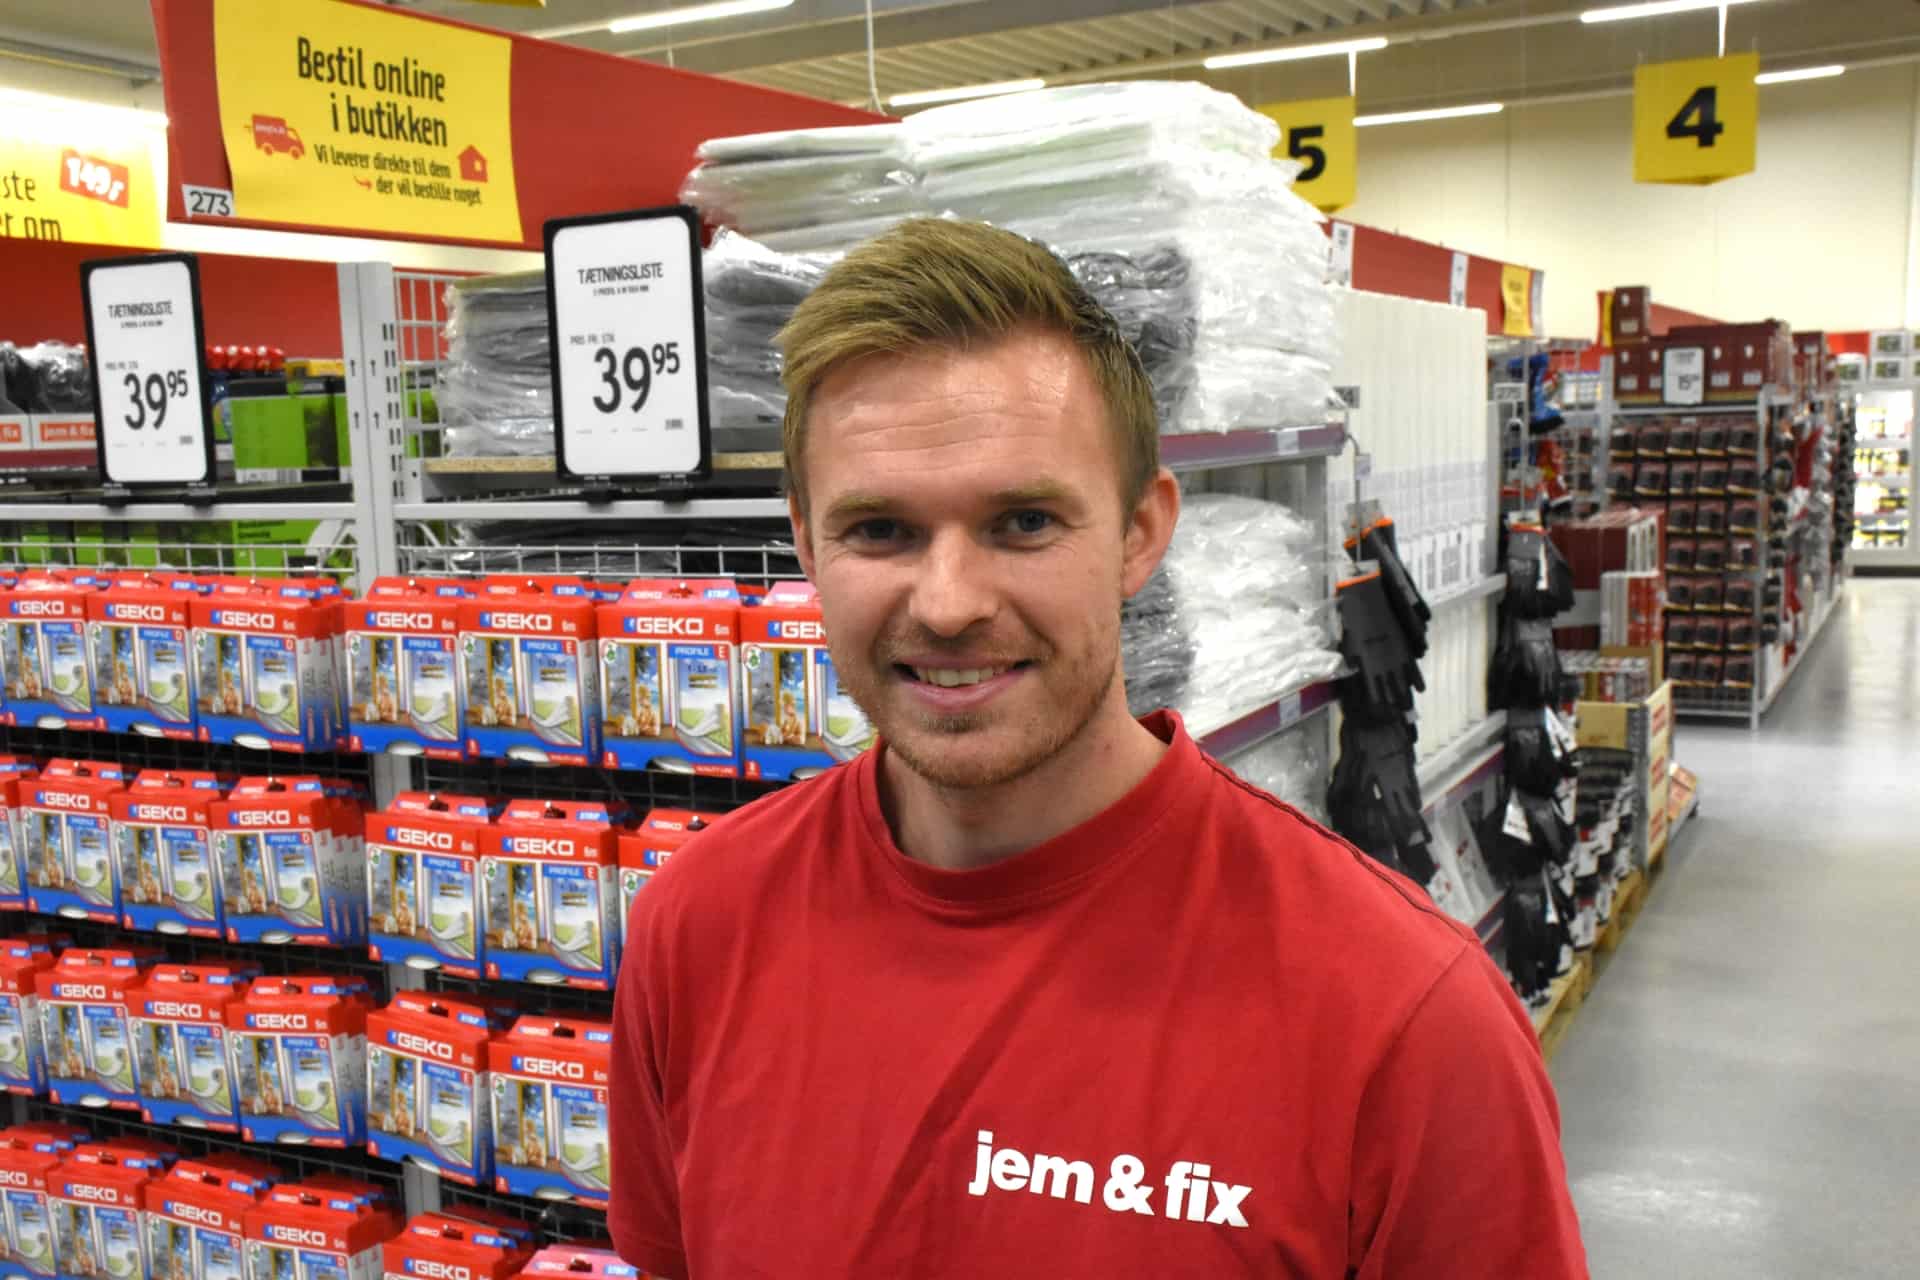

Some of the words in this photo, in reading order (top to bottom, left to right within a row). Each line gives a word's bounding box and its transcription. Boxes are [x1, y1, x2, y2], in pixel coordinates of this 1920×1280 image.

[298, 36, 366, 89] Bestil
[374, 57, 445, 102] online
[331, 92, 339, 132] i
[346, 95, 448, 147] butikken
[1666, 85, 1724, 148] 4
[315, 144, 328, 163] Vi
[331, 147, 369, 169] leverer
[374, 152, 410, 174] direkte
[413, 158, 427, 176] til
[1288, 125, 1326, 182] 5
[376, 176, 392, 194] der
[398, 179, 412, 196] vil
[415, 181, 451, 200] bestille
[190, 190, 230, 216] 273
[19, 601, 65, 614] GEKO
[115, 604, 164, 620] GEKO
[221, 611, 275, 629] GEKO
[377, 612, 432, 629] GEKO
[491, 613, 552, 630] GEKO
[636, 617, 703, 634] GEKO
[781, 621, 825, 639] GEK
[44, 792, 90, 809] GEKO
[138, 805, 187, 820] GEKO
[239, 810, 290, 825] GEKO
[397, 828, 453, 849] GEKO
[513, 838, 574, 856] GEKO
[61, 984, 106, 999] GEKO
[154, 1001, 201, 1018] GEKO
[256, 1014, 307, 1030] GEKO
[397, 1031, 453, 1059] GEKO
[524, 1057, 584, 1079] GEKO
[968, 1130, 1095, 1204] jem
[1103, 1154, 1155, 1216] &
[1165, 1161, 1252, 1228] fix
[73, 1184, 117, 1201] GEKO
[173, 1202, 222, 1226] GEKO
[274, 1226, 326, 1246] GEKO
[414, 1261, 470, 1280] GEKO
